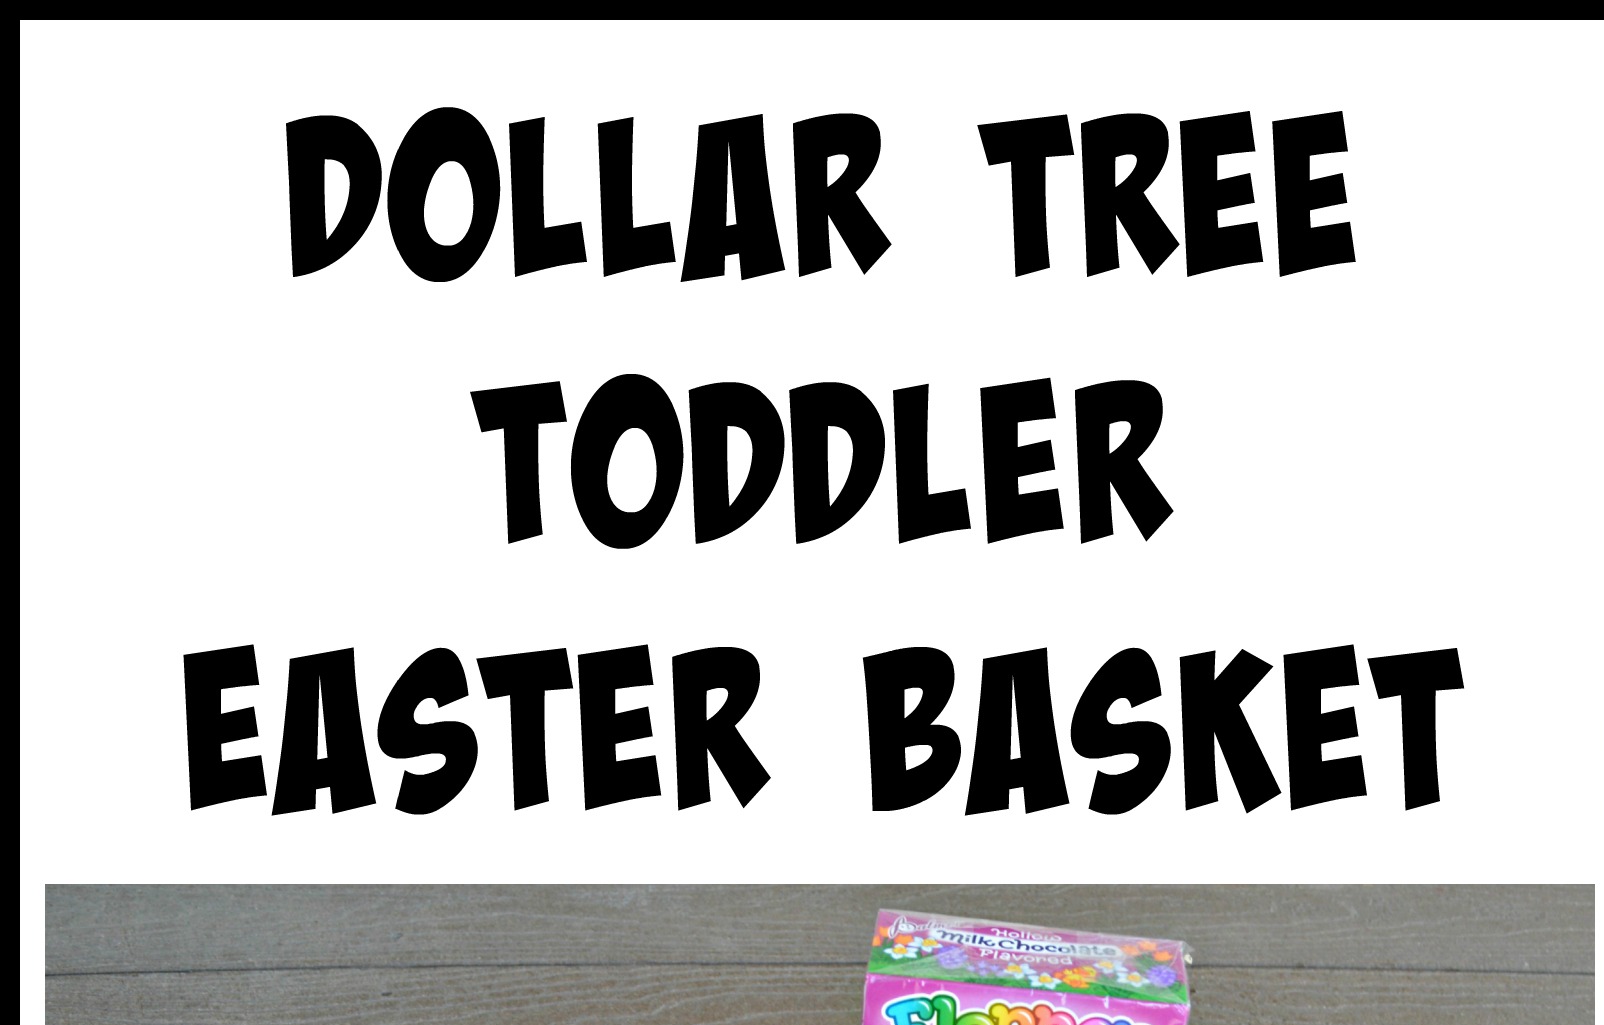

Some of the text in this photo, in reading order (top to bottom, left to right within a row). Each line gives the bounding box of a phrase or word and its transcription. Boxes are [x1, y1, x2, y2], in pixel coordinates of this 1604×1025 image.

[935, 929, 1118, 957] Milk Chocolate
[990, 927, 1062, 943] Hollow
[979, 948, 1073, 966] Flavored
